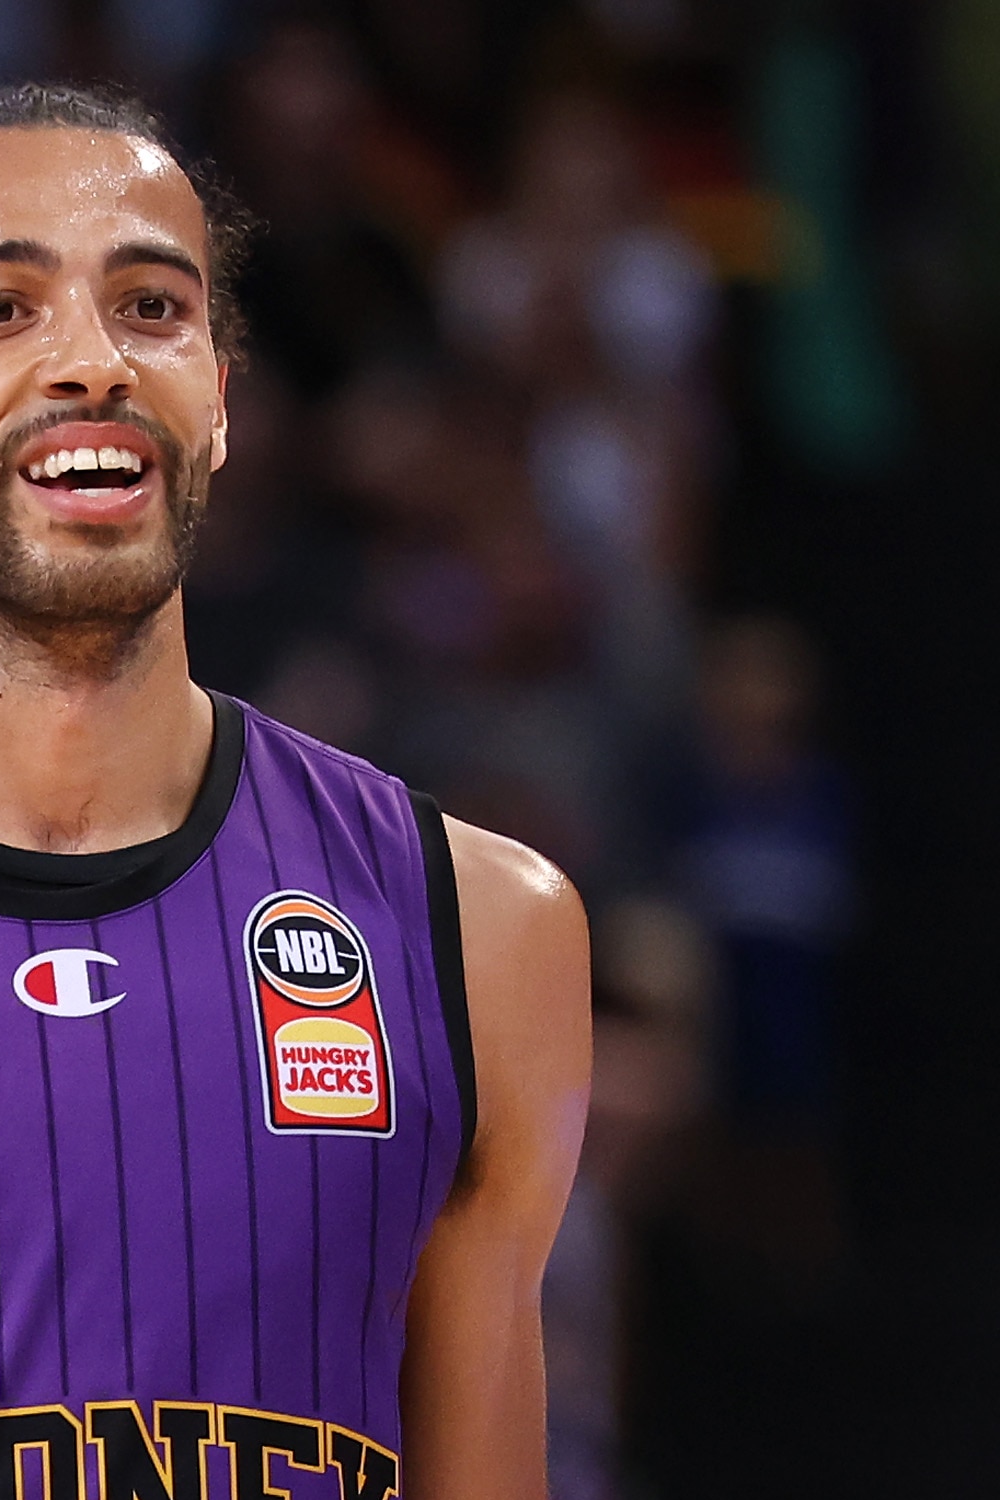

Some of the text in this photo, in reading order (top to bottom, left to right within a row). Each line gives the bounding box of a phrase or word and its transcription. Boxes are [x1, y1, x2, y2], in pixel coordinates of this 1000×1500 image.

[274, 928, 346, 975] NBL
[281, 1047, 370, 1066] HUNGRY
[285, 1067, 374, 1095] JACK'S
